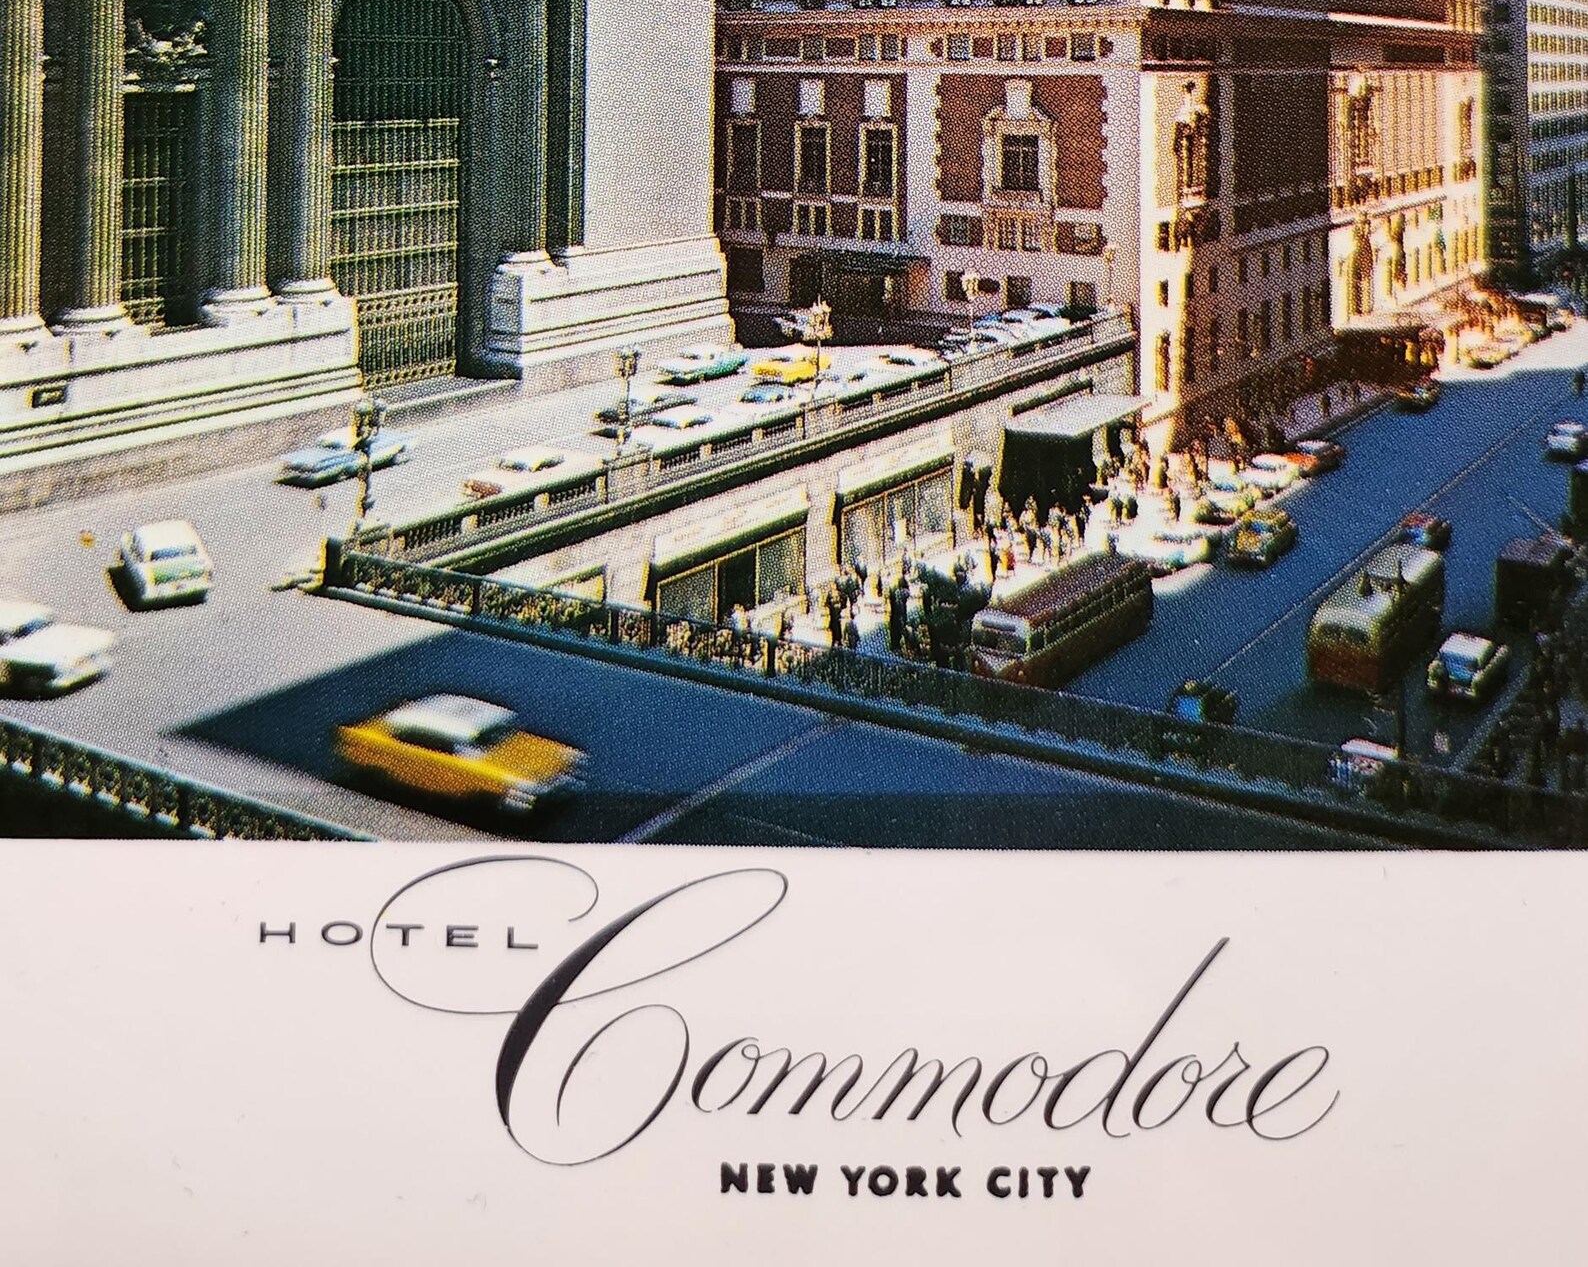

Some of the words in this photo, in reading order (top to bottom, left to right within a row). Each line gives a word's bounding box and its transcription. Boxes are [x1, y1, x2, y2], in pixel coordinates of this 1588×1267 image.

[258, 921, 540, 951] HOTEL
[369, 854, 1341, 1167] Commodore
[719, 1162, 819, 1196] NEW
[839, 1164, 963, 1199] YORK
[985, 1165, 1092, 1200] CITY
